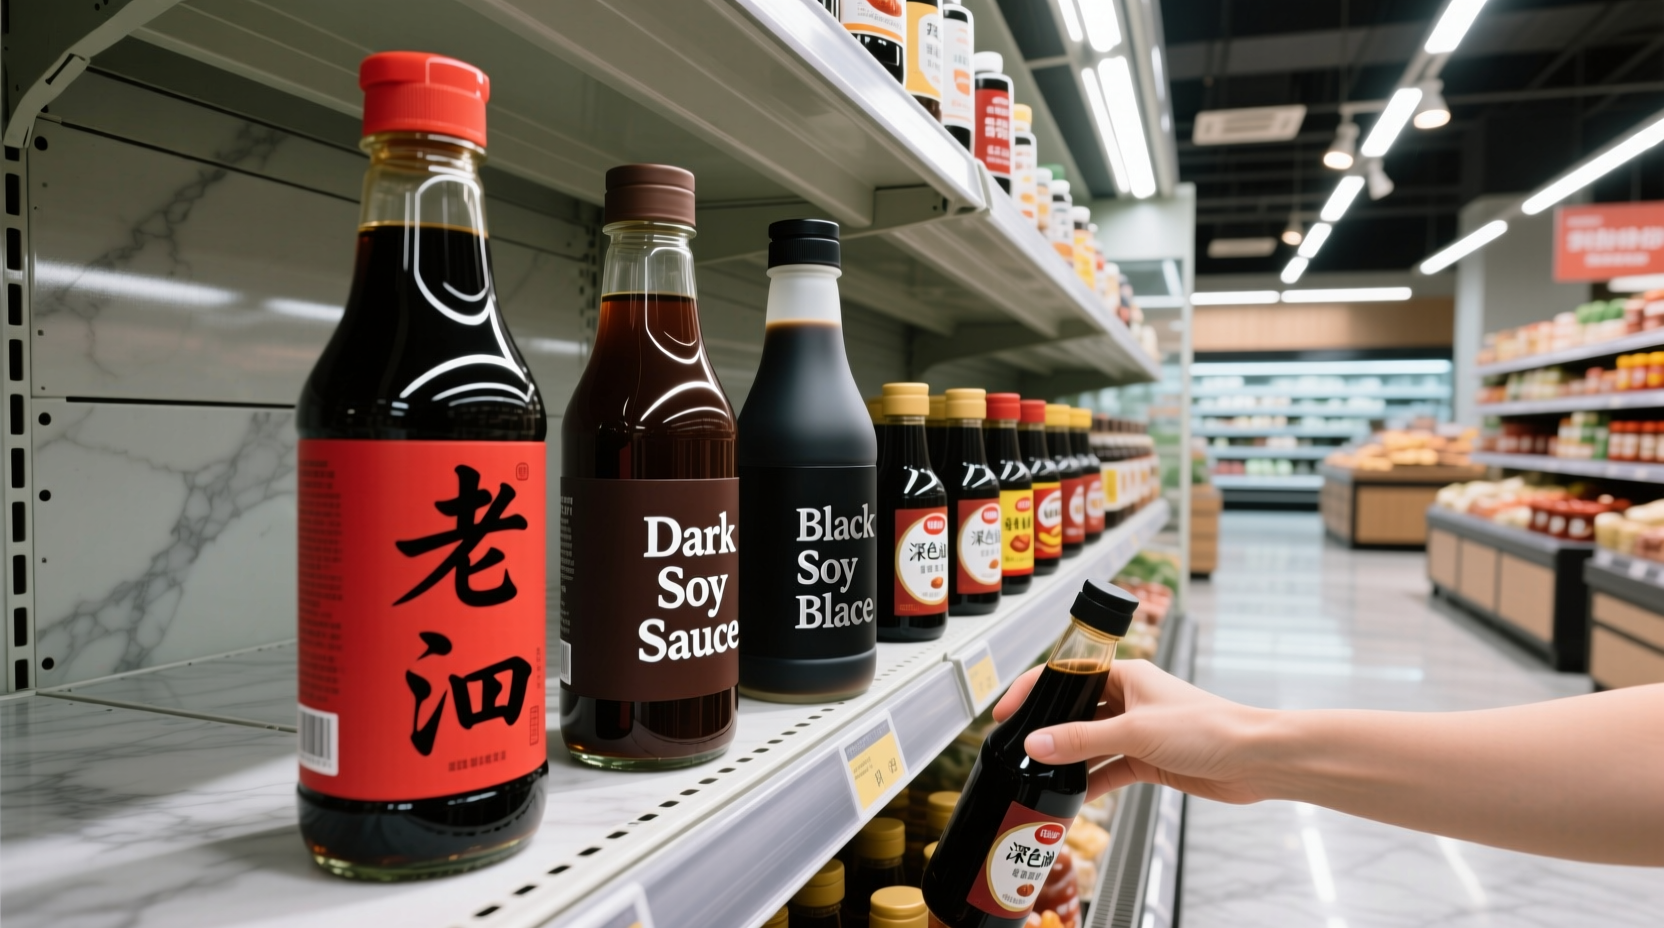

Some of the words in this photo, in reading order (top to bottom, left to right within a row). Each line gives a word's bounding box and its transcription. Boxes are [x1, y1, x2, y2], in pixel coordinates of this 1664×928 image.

[644, 511, 737, 558] Dark
[796, 503, 875, 542] Black
[657, 566, 728, 618] Soy
[797, 549, 859, 593] Soy
[795, 591, 874, 629] Blace
[638, 616, 739, 663] Sauce
